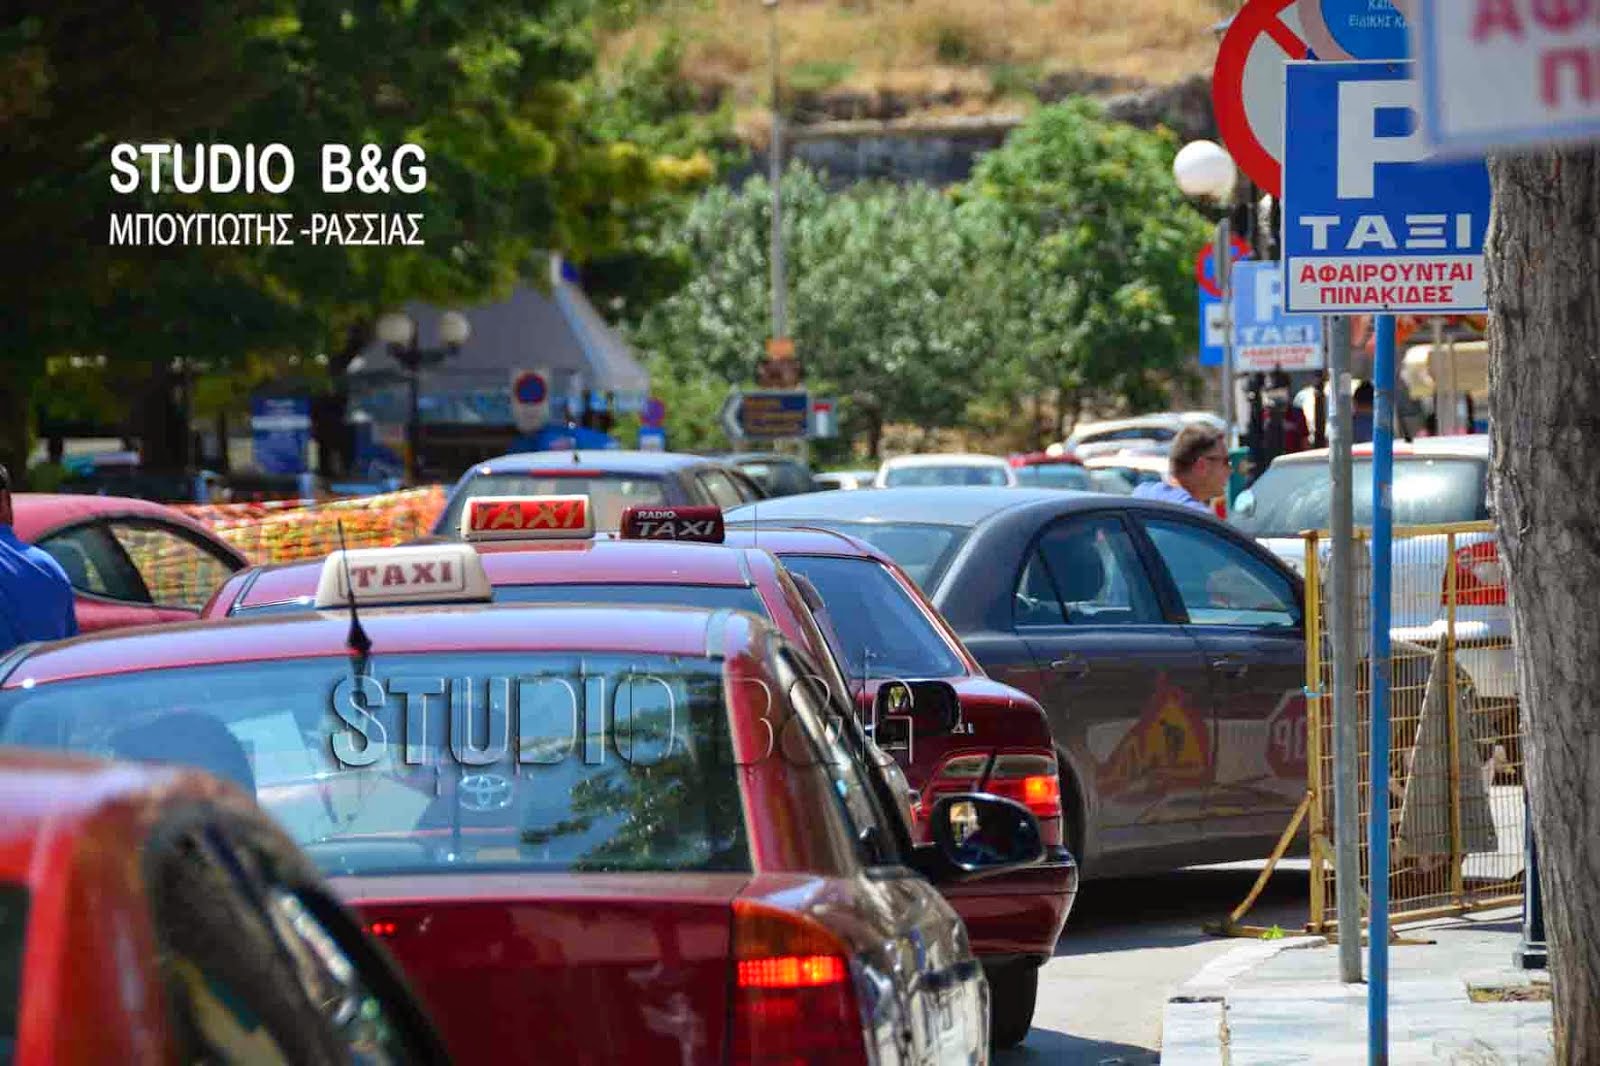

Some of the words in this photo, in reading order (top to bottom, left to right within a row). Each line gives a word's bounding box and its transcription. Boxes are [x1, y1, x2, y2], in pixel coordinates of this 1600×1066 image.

[1299, 213, 1472, 250] ΤΑΞΙ
[1300, 263, 1473, 284] ΑΦΑΙΡΟΥΝΤΑΙ
[1320, 285, 1453, 305] ΠΙΝΑΚΙΔΕΣ
[472, 503, 583, 529] TAXI
[638, 510, 676, 519] RADIO
[636, 520, 715, 537] TAXI
[351, 561, 453, 588] TAXI
